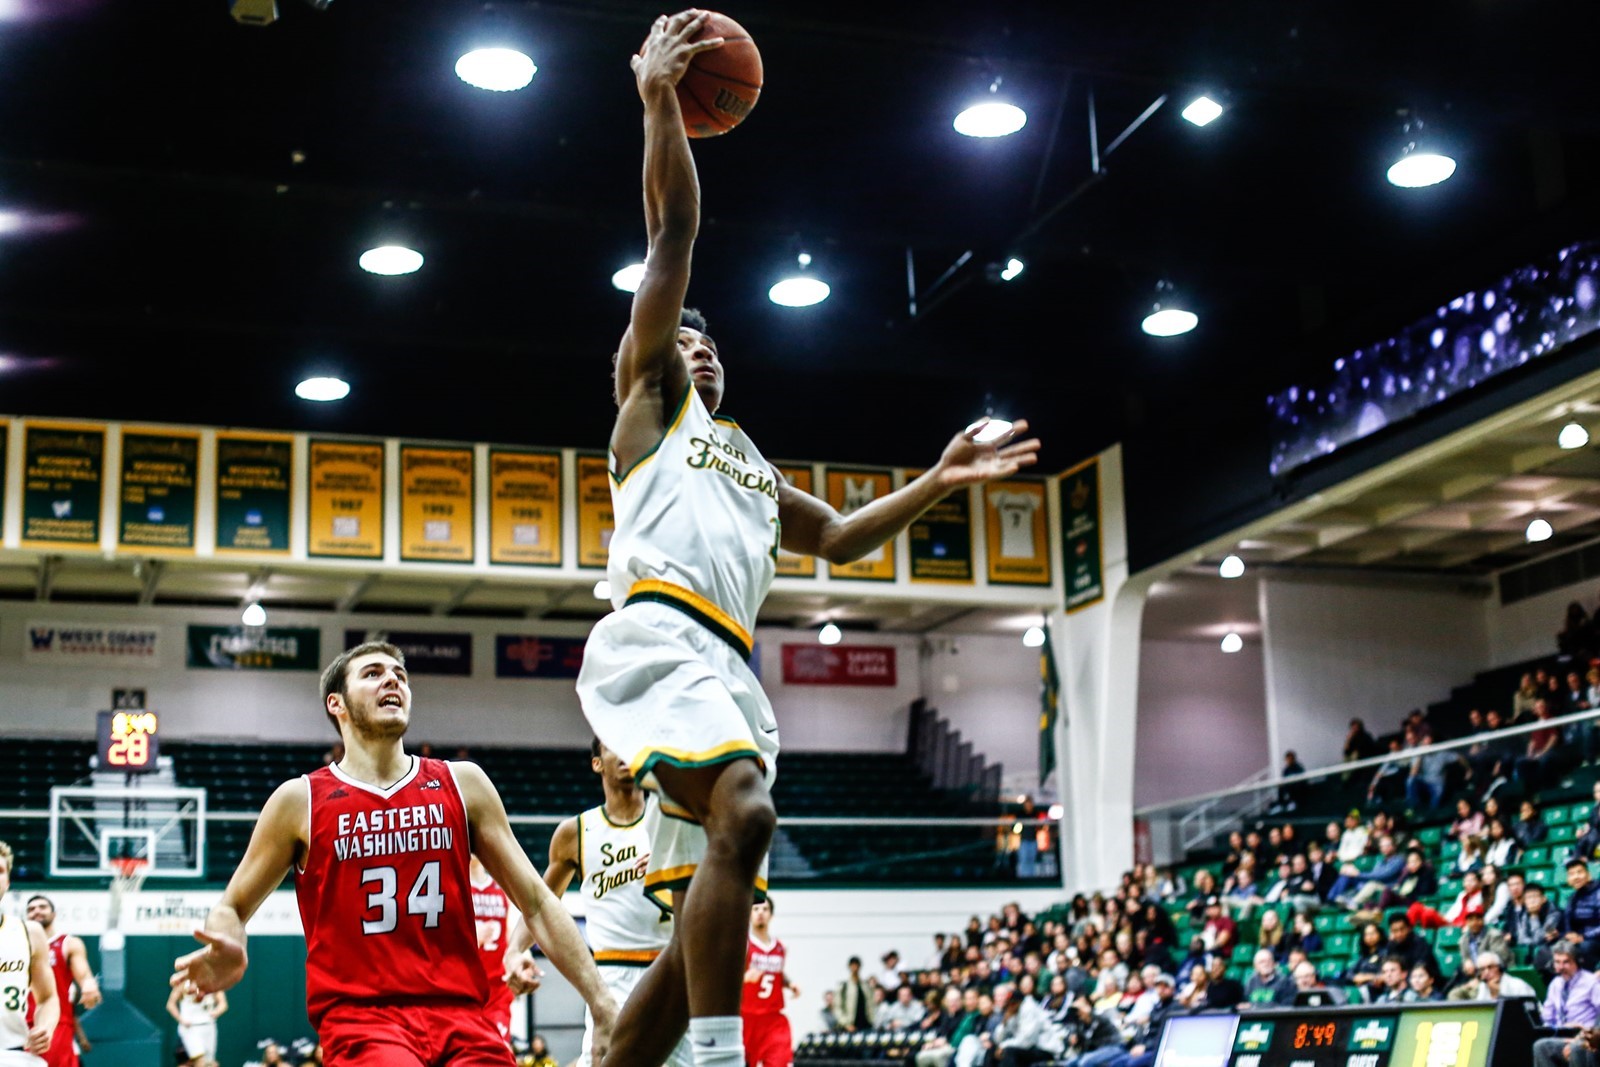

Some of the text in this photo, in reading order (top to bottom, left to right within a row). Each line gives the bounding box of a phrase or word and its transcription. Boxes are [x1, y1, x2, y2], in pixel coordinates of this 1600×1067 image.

[686, 437, 779, 506] Francis
[59, 629, 103, 643] WEST
[400, 644, 461, 659] ORTLAND
[108, 732, 149, 766] 28
[338, 803, 444, 836] EASTERN
[333, 827, 453, 862] WASHINGTON
[600, 843, 637, 867] San
[592, 861, 647, 899] Franc
[361, 861, 444, 935] 34
[758, 974, 776, 998] 5
[1294, 1022, 1336, 1048] 8:49
